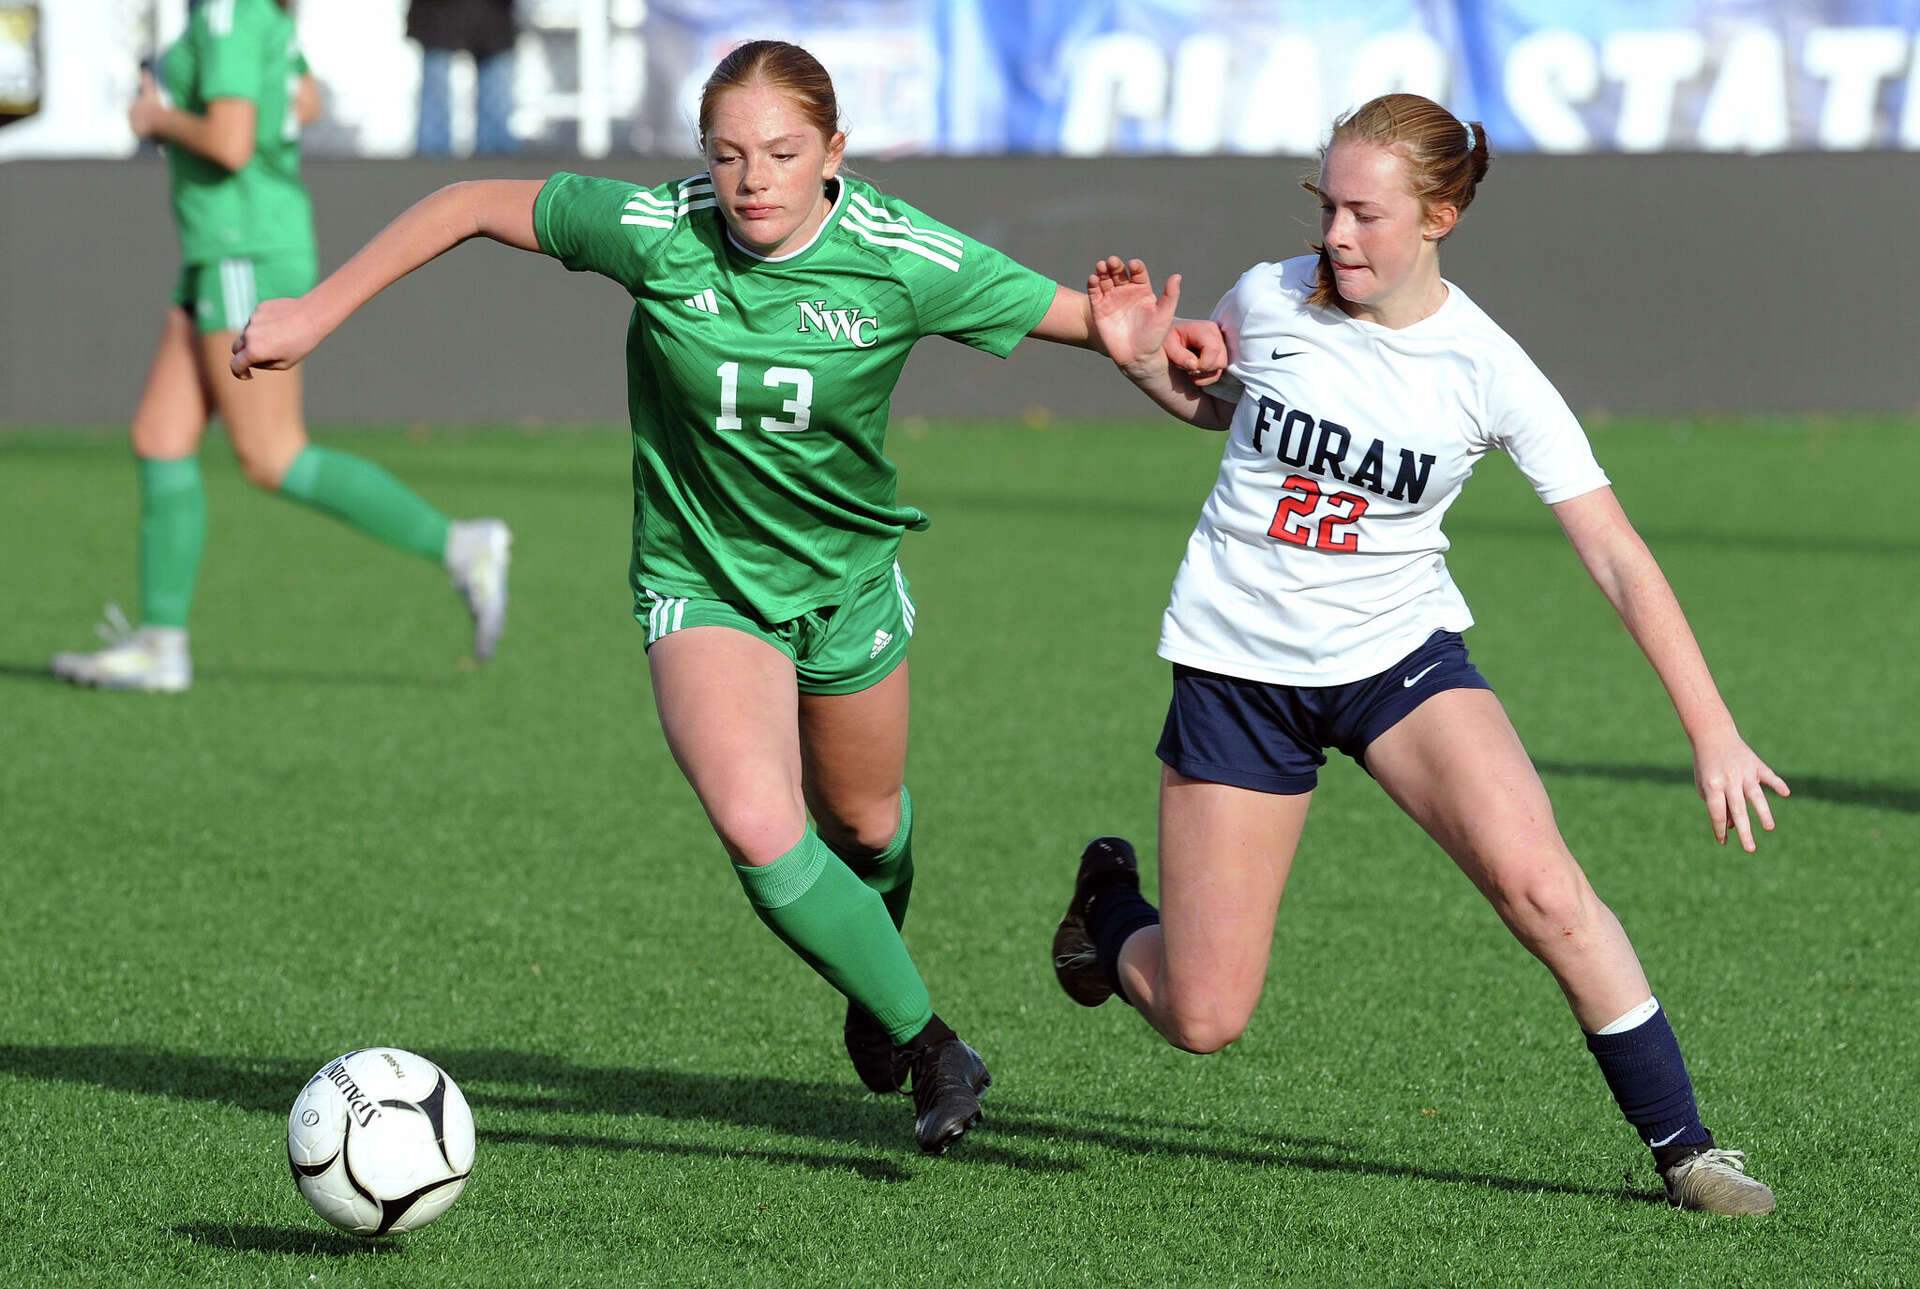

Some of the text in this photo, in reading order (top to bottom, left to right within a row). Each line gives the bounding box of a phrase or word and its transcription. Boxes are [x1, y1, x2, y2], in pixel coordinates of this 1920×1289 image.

[796, 300, 878, 348] NWC
[715, 361, 814, 432] 13
[1252, 395, 1436, 504] FORAN
[1267, 474, 1369, 552] 22
[323, 1060, 382, 1128] SPALDIN
